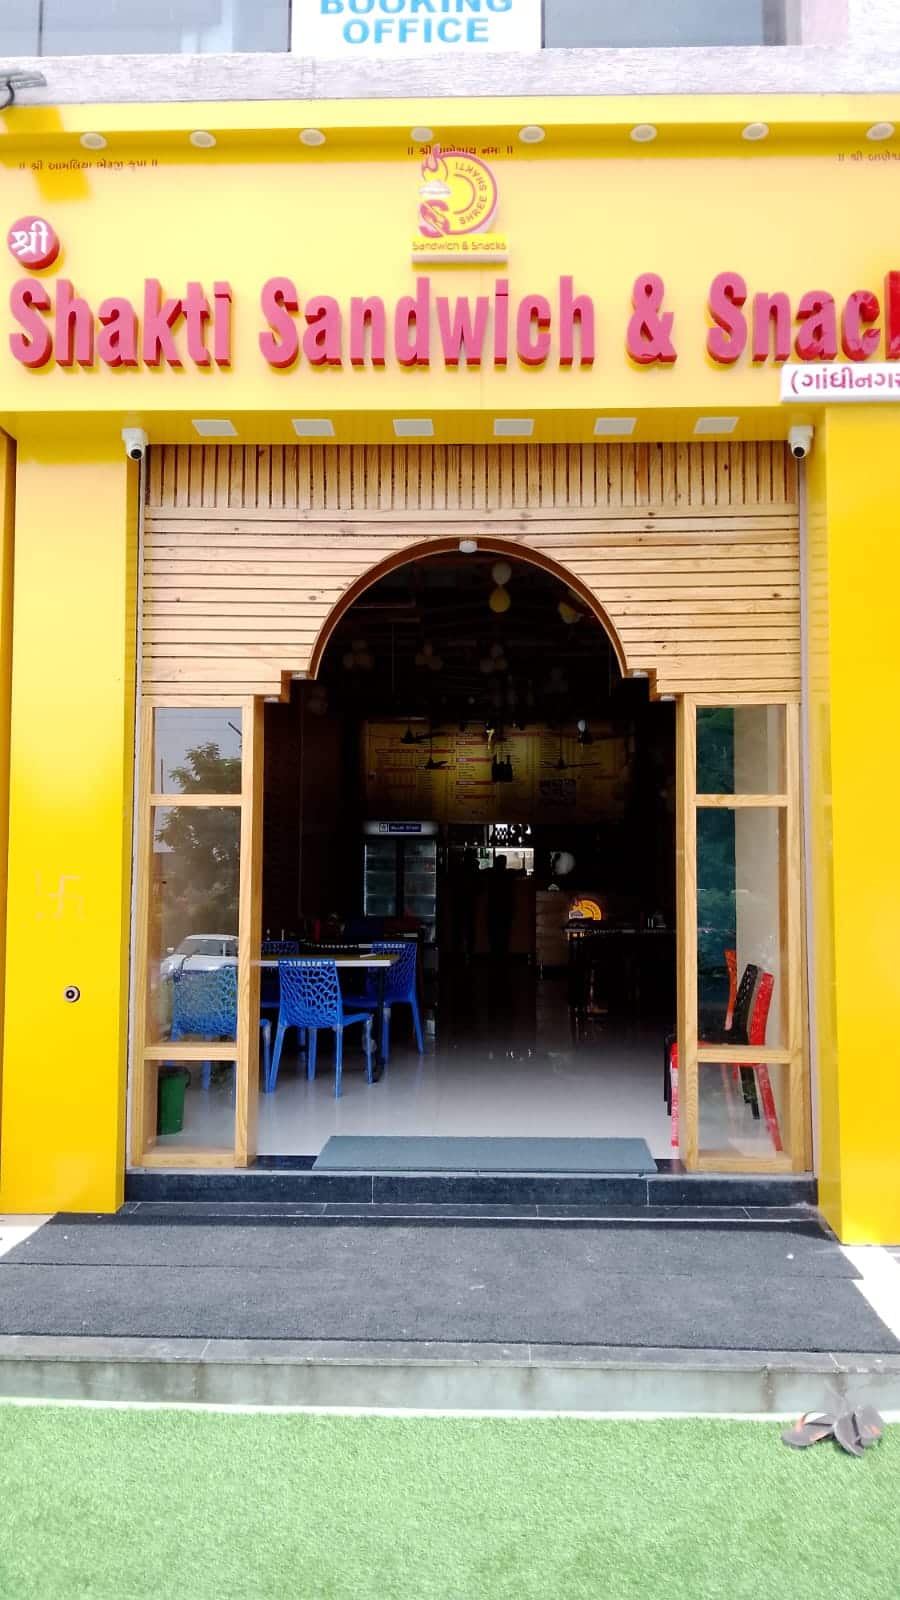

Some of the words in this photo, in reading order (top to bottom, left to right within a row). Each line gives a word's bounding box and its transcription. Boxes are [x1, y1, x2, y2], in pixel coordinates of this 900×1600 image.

[319, 0, 513, 15] BOOKING
[342, 17, 489, 44] OFFICE
[455, 161, 488, 192] SHAKTI
[458, 195, 488, 225] SHREE
[412, 241, 460, 251] Sandwich
[471, 240, 507, 251] Snacks
[9, 277, 232, 368] Shakti
[258, 275, 596, 369] Sandwich
[627, 271, 678, 365] &
